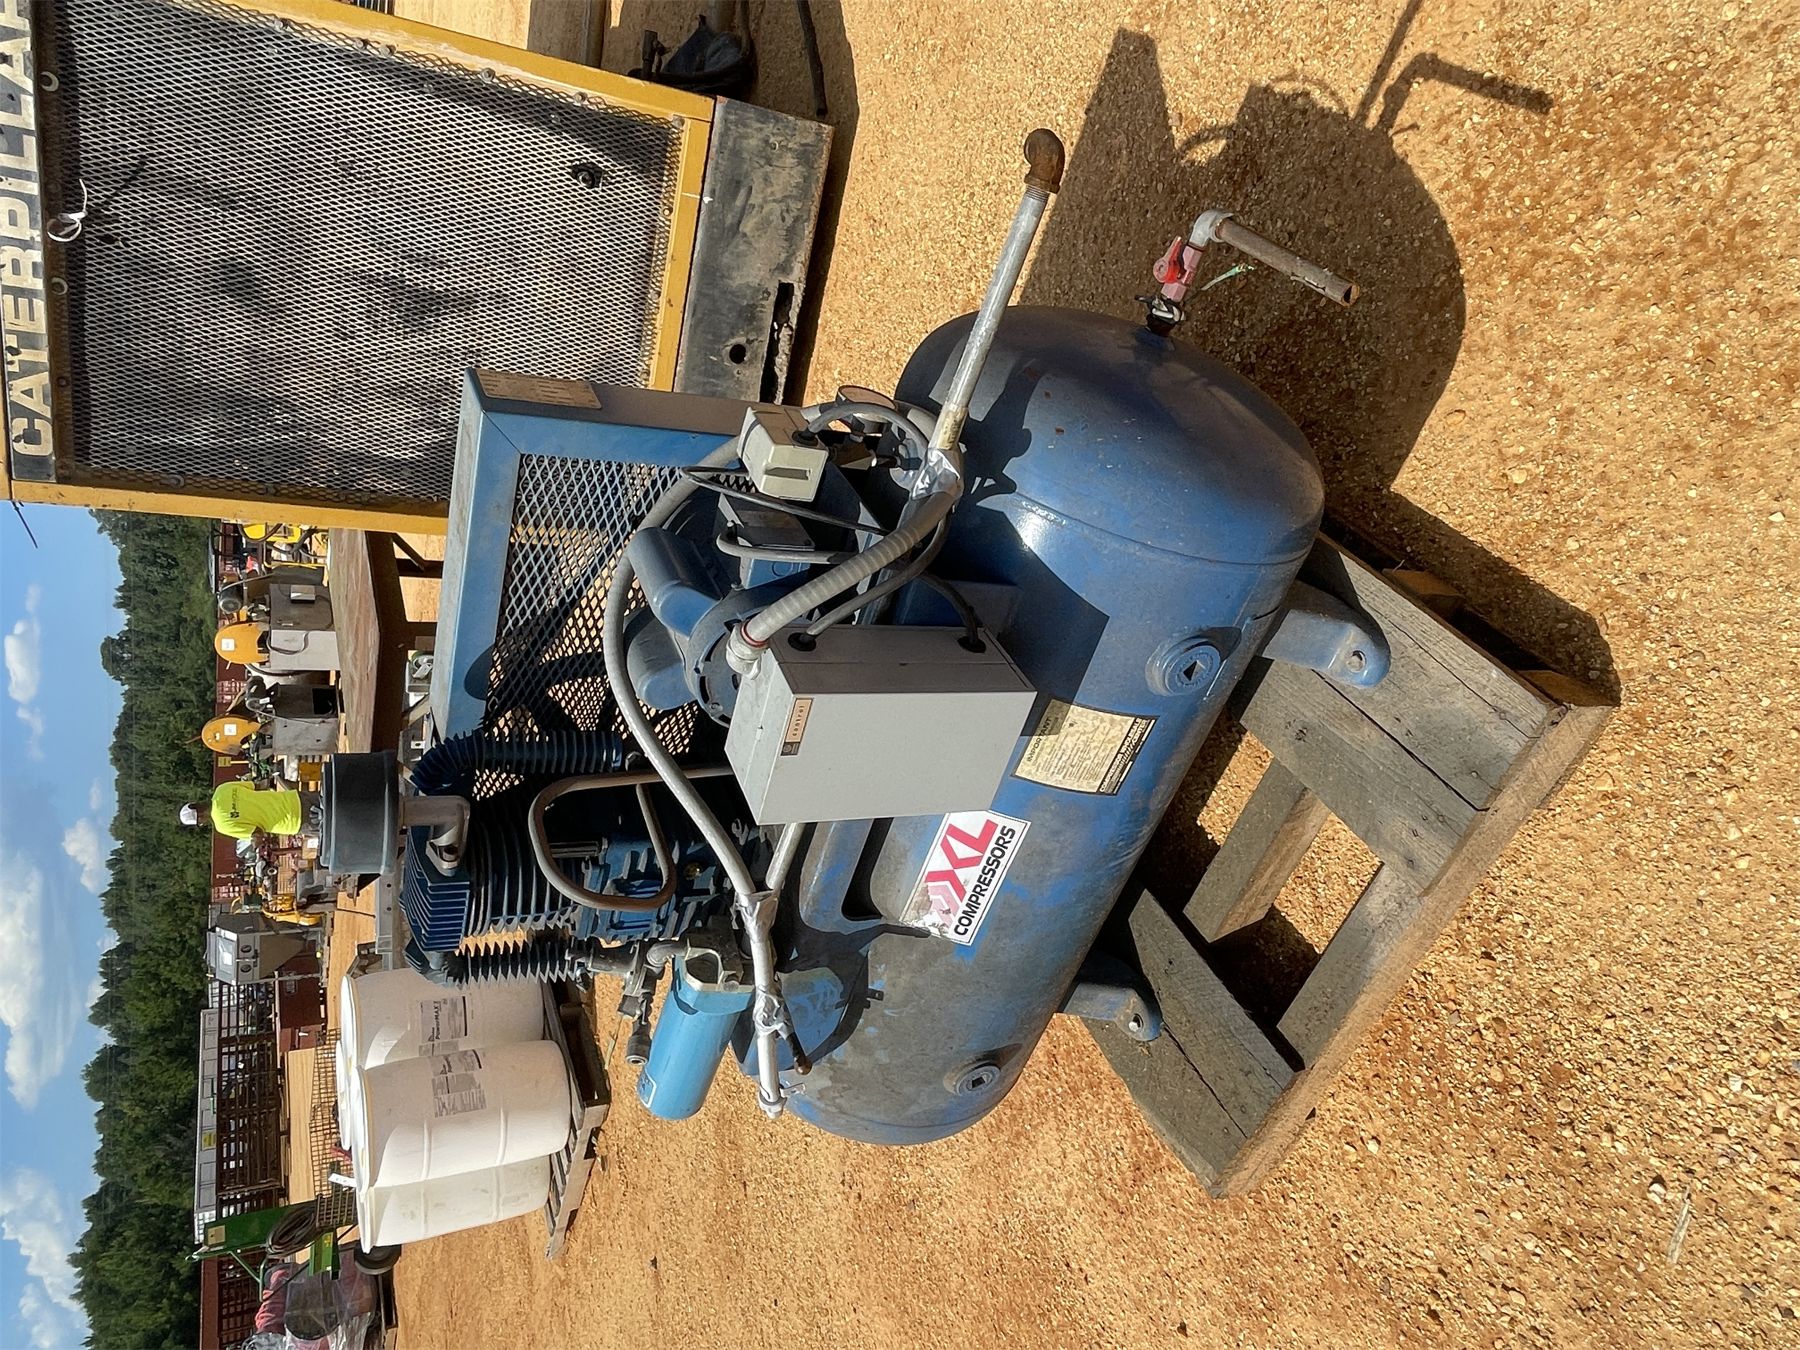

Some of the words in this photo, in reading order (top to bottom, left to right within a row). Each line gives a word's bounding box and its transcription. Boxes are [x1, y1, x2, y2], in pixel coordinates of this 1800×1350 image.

[792, 705, 805, 736] control
[1026, 716, 1052, 762] IMPORTANT
[953, 825, 1016, 936] COMPRESSORS
